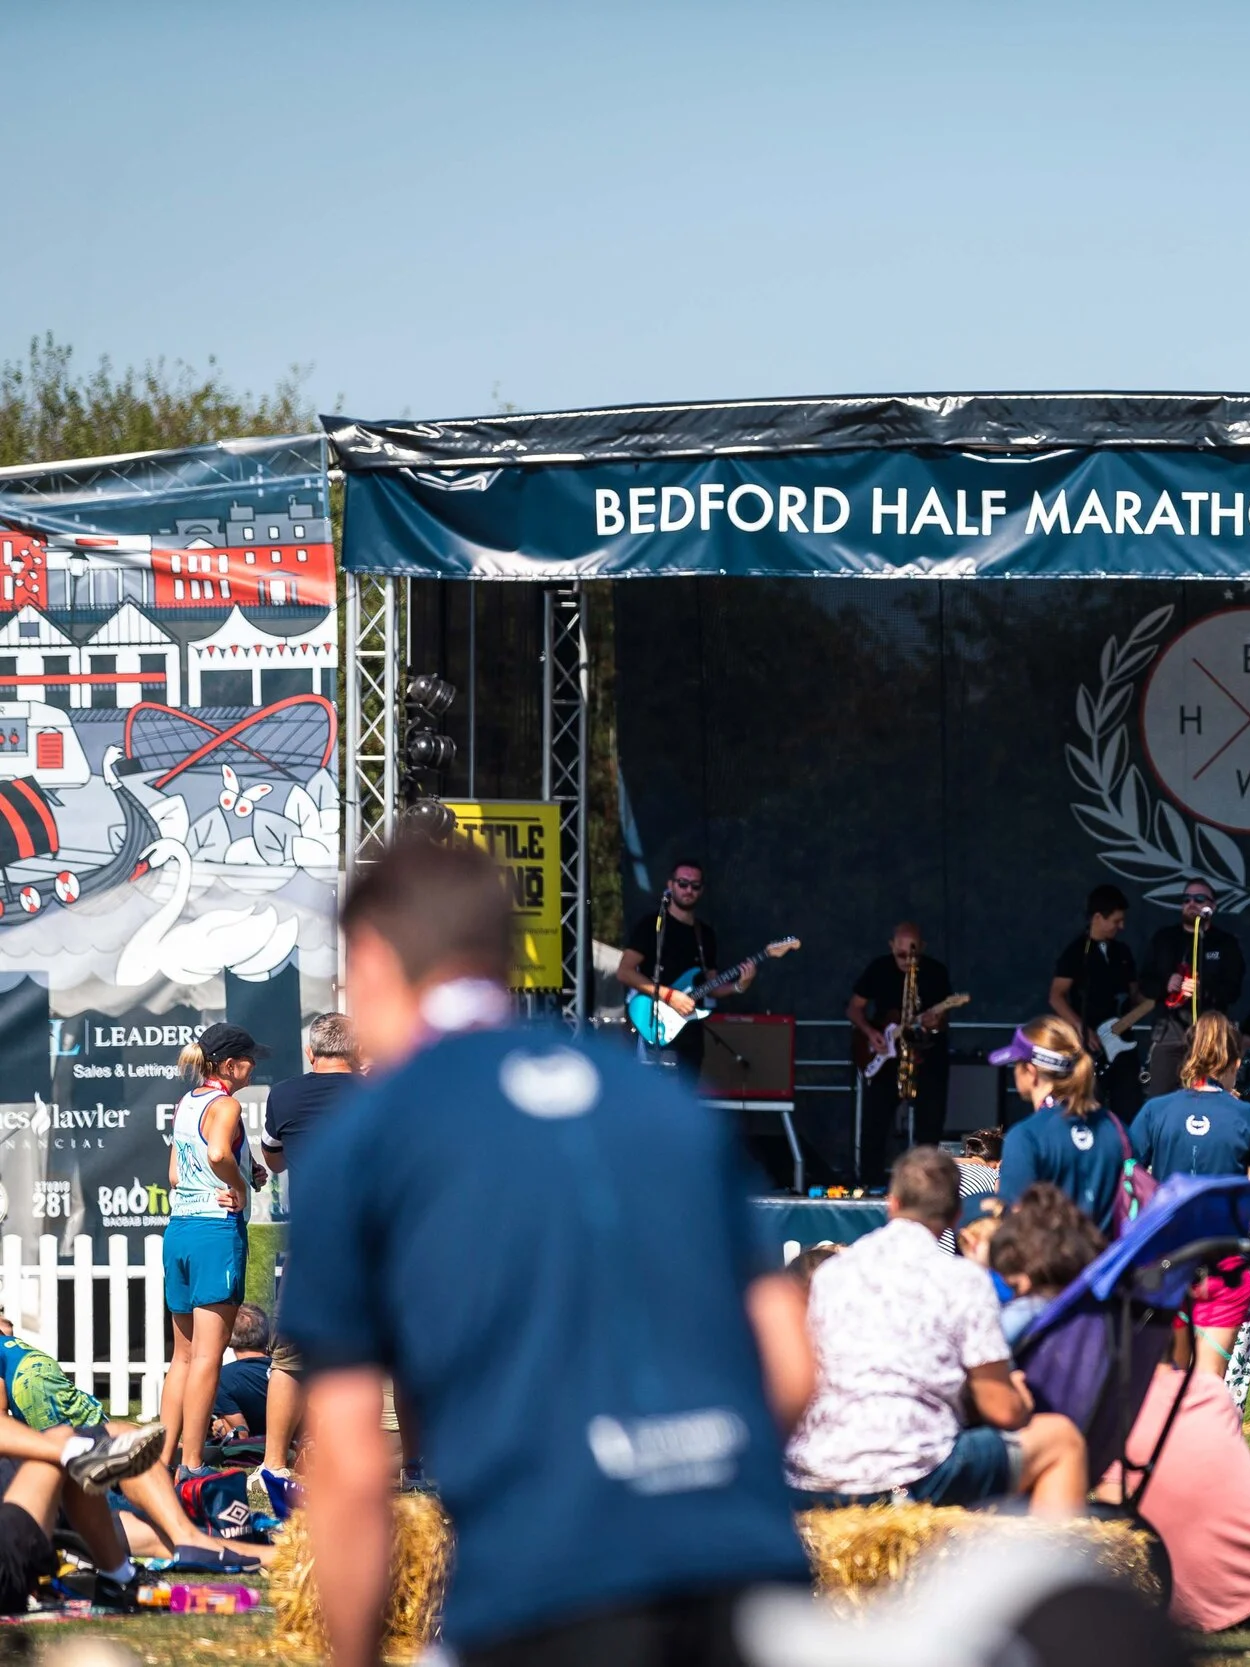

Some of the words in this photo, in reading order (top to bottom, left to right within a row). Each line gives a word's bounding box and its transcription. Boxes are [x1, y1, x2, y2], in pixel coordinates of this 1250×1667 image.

[595, 483, 851, 536] BEDFORD
[872, 486, 1006, 536] HALF
[1179, 704, 1203, 736] H
[73, 1063, 112, 1079] Sales
[114, 1063, 126, 1078] &
[52, 1102, 130, 1129] lawler
[32, 1192, 72, 1219] 281
